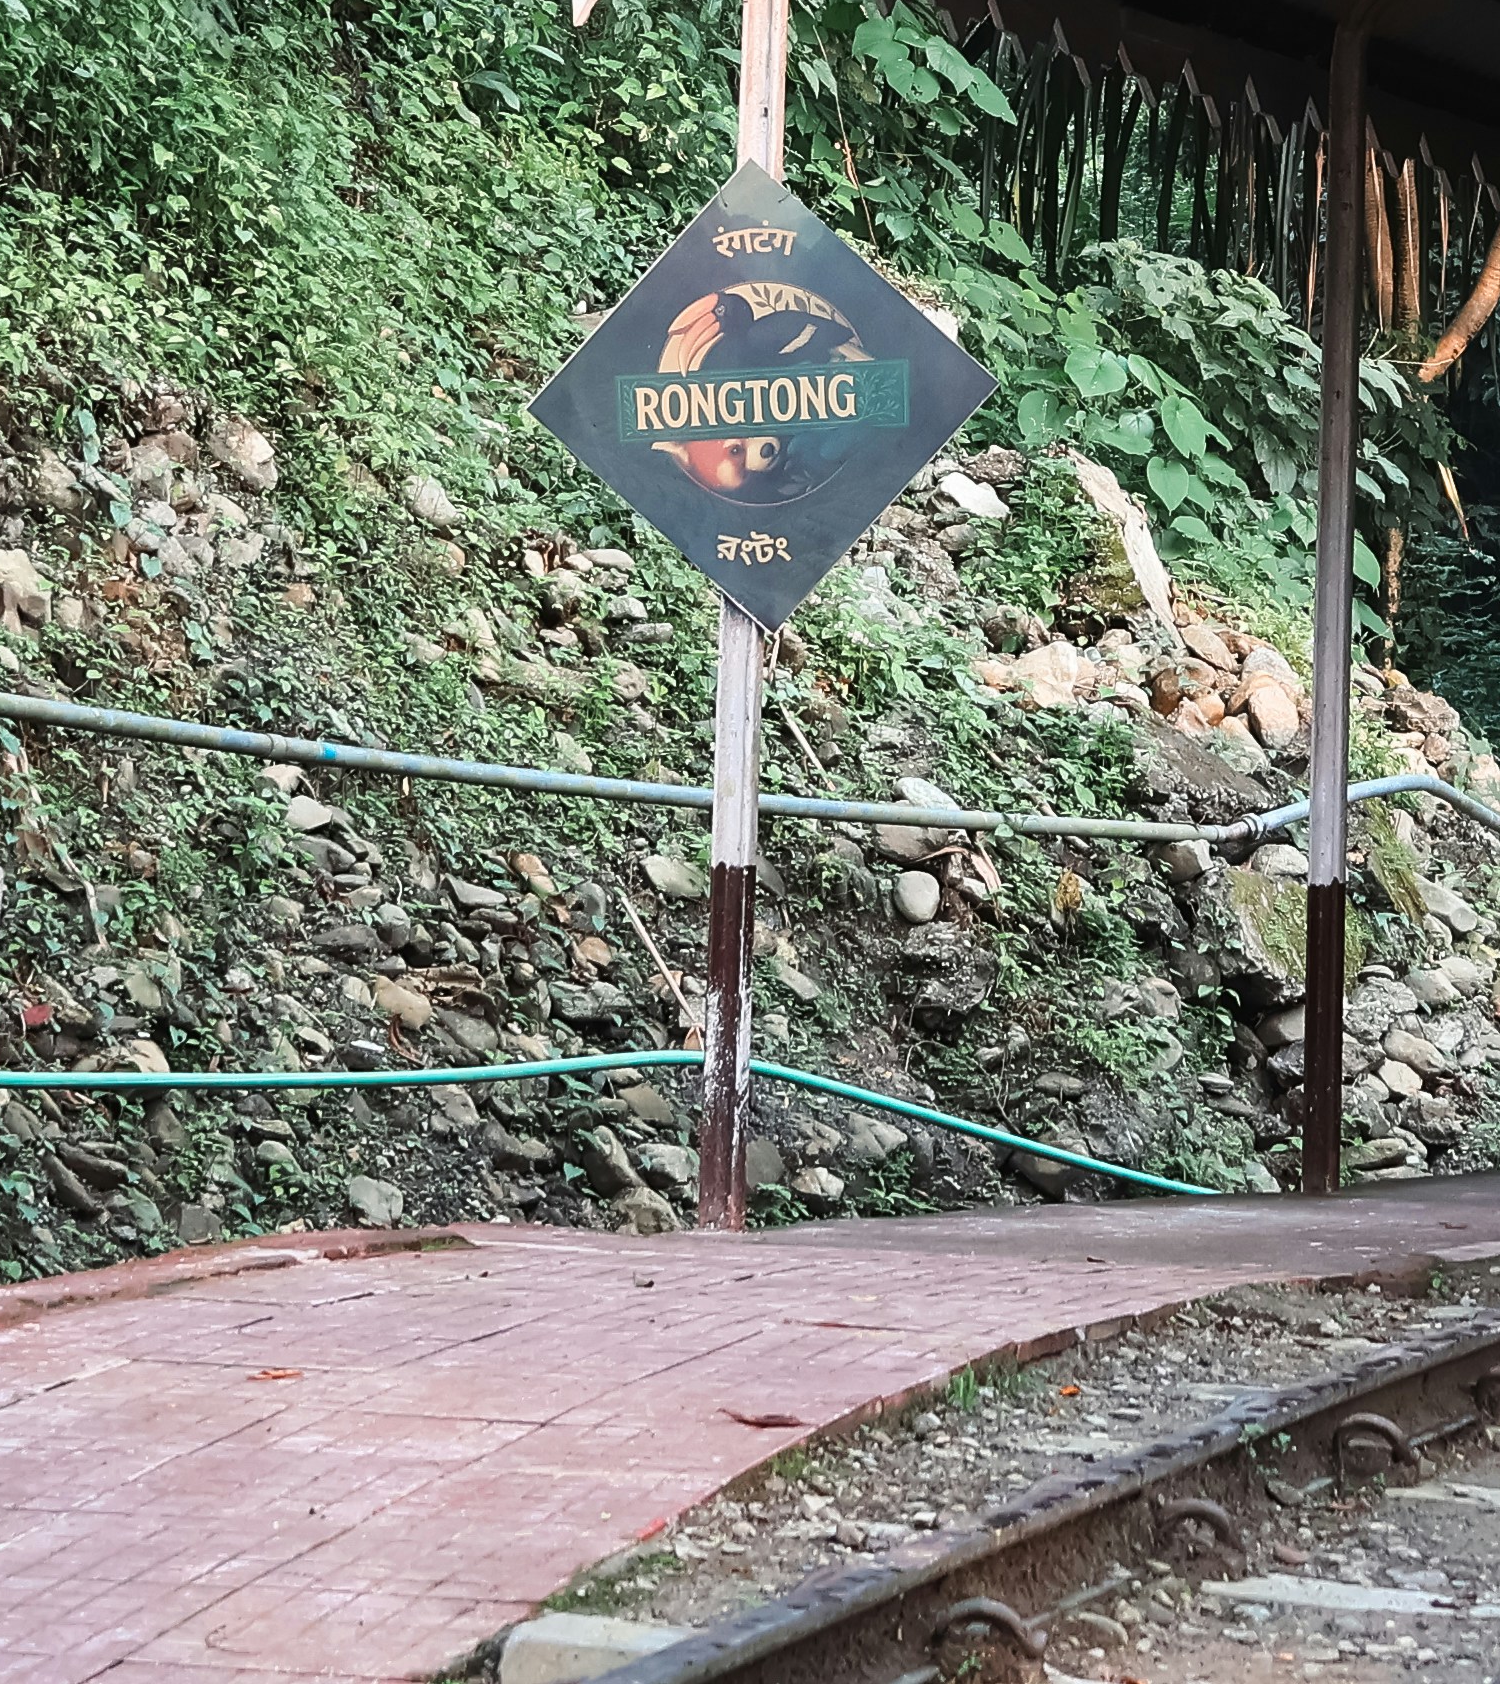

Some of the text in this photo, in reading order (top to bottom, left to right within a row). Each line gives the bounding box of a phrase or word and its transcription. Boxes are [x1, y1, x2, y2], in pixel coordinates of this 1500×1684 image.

[713, 220, 798, 258] रंगटंग
[634, 374, 857, 431] RONGTONG
[717, 530, 793, 566] রংটং
